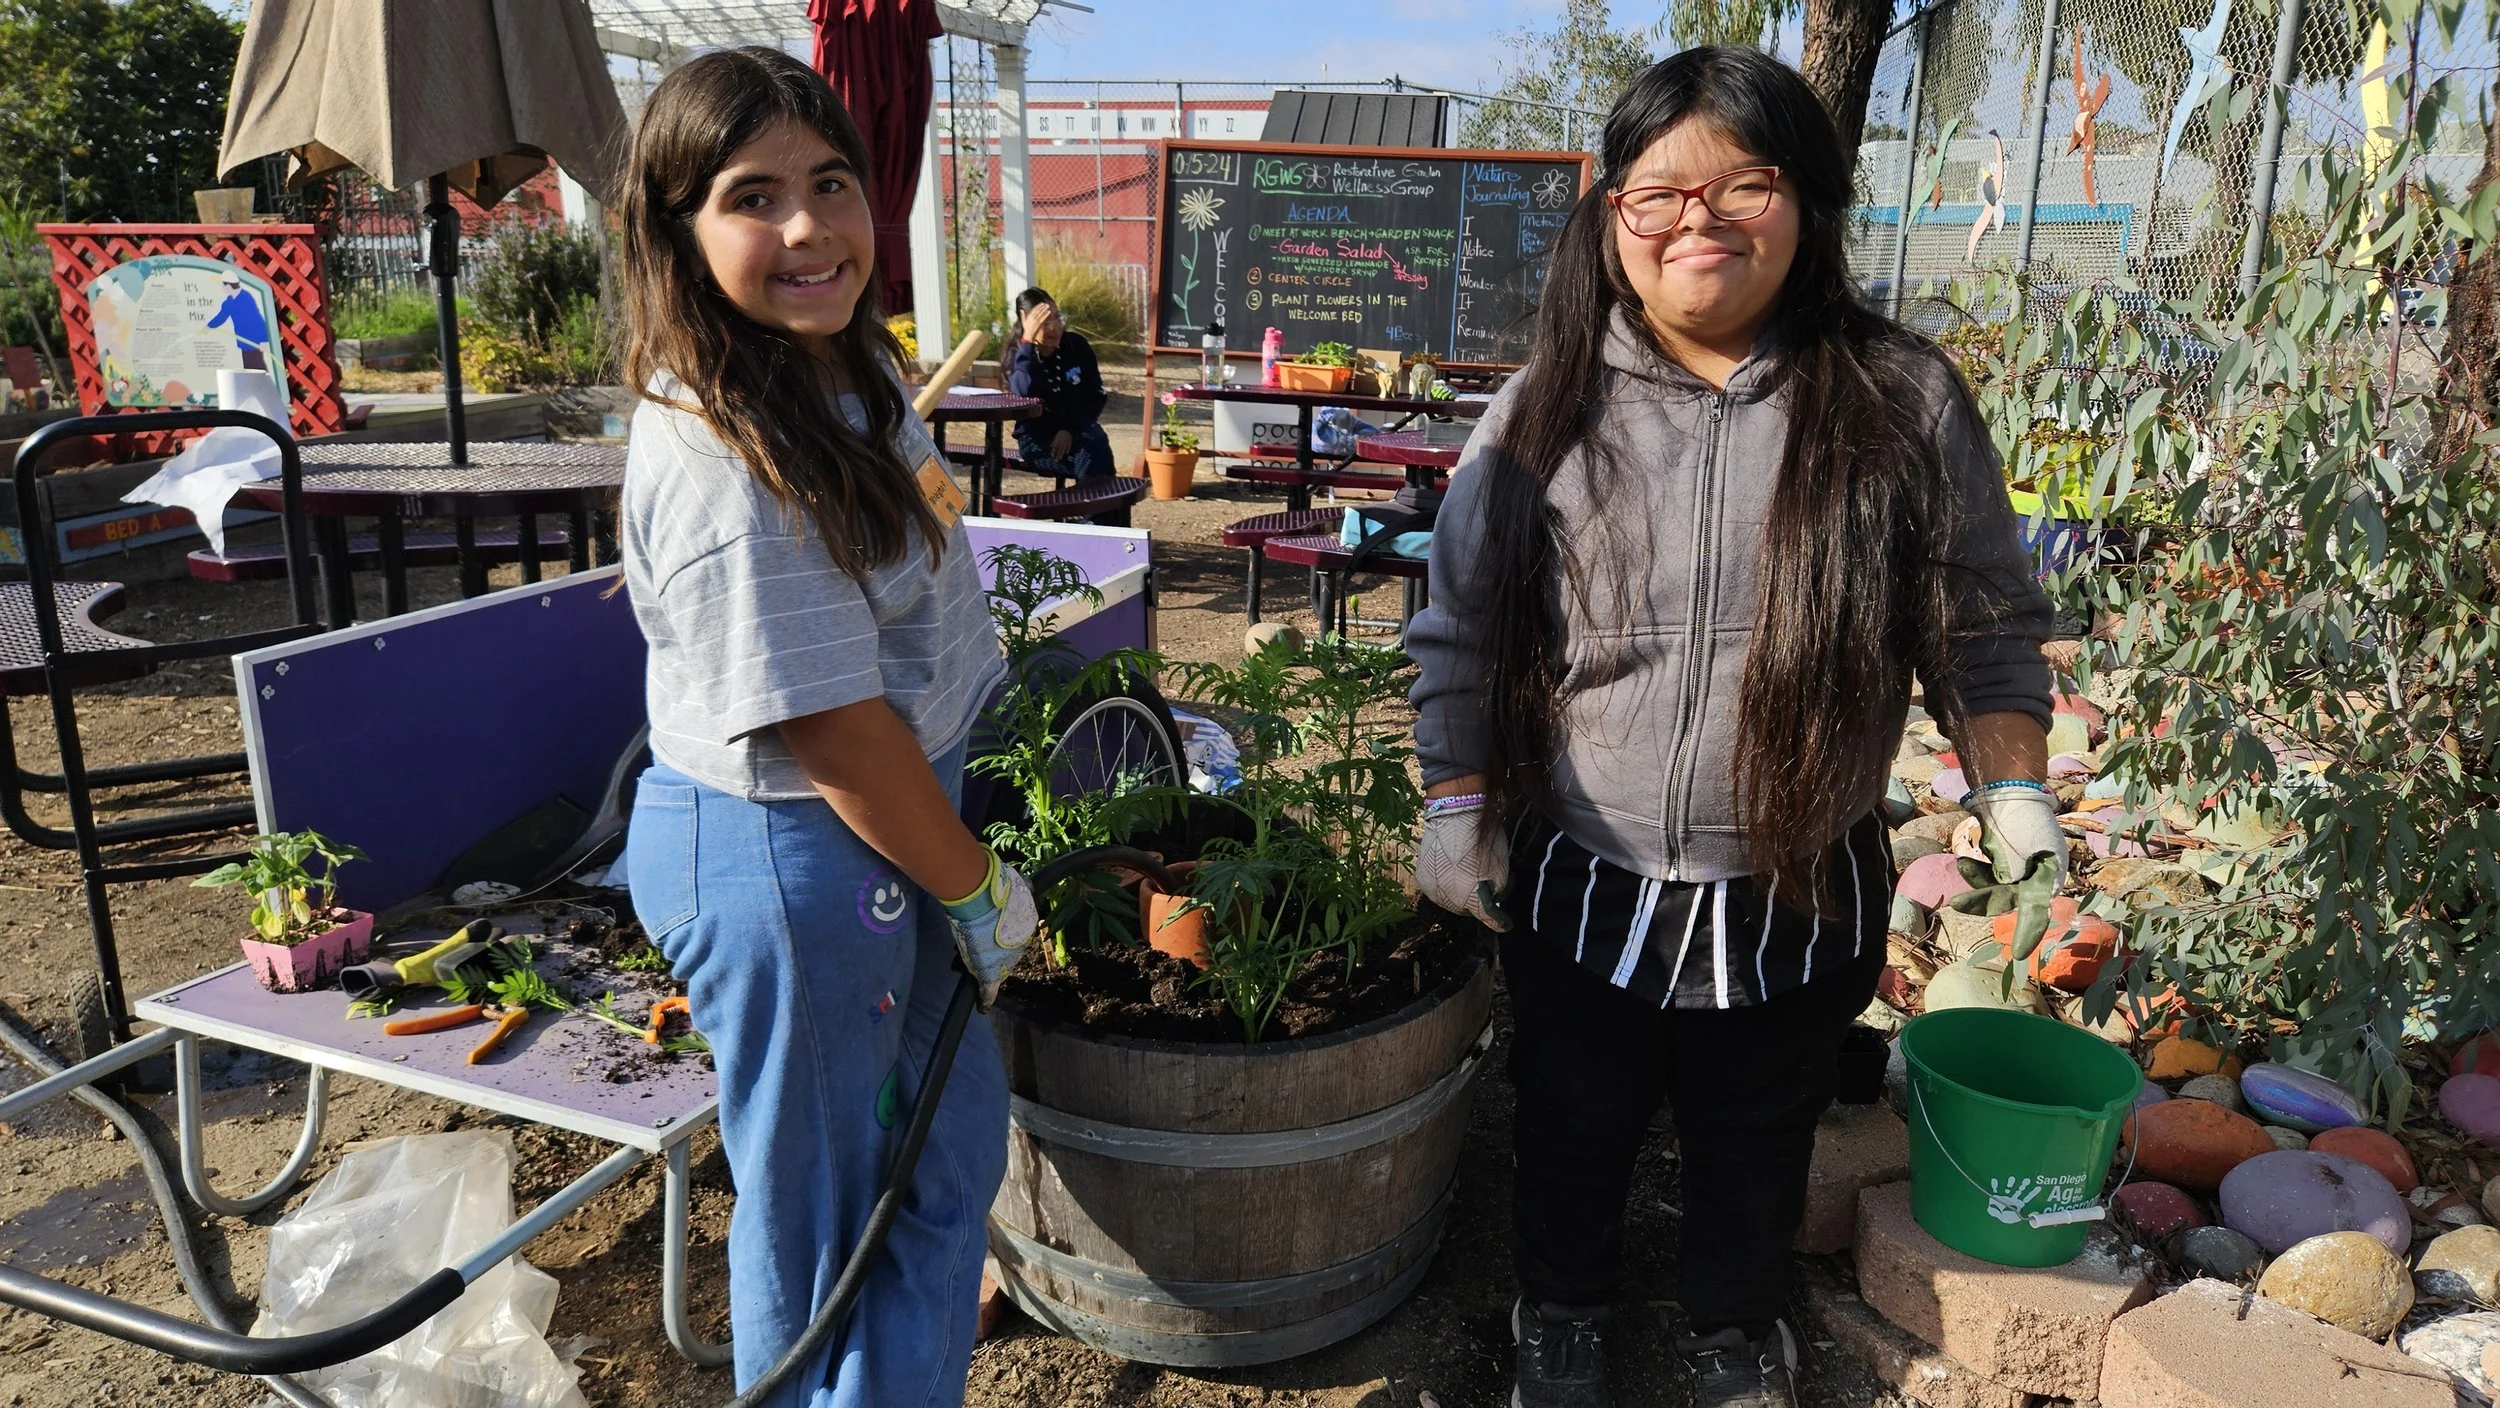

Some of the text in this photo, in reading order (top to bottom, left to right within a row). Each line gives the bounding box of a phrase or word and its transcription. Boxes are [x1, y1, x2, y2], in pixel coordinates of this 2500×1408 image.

[1039, 116, 1049, 132] SS
[1065, 116, 1075, 132] TT
[1141, 117, 1156, 132] WW
[1199, 117, 1209, 133] YY
[1226, 117, 1235, 133] ZZ
[1252, 158, 1308, 189] RGWG
[1333, 160, 1396, 178] Restorative
[1467, 163, 1521, 182] Nature
[1332, 178, 1435, 198] Wellness Group
[1465, 183, 1530, 210] Journaling
[1287, 202, 1354, 222] AGENDA
[1262, 228, 1287, 238] MEET
[1289, 228, 1299, 238] AT
[1301, 228, 1328, 239] WORK
[1330, 229, 1368, 240] BENCH
[1374, 228, 1421, 240] GARDEN
[1422, 227, 1455, 240] SNACK
[1462, 216, 1475, 236] I
[1336, 238, 1384, 259] Salad
[1426, 246, 1448, 256] FOR
[1461, 237, 1494, 257] Notice
[1459, 256, 1473, 271] I
[184, 281, 199, 292] It's
[1213, 227, 1234, 337] WELCOM
[1268, 273, 1310, 285] CENTER
[1313, 275, 1353, 287] CIRCLE
[1459, 273, 1496, 291] Wonder
[187, 297, 196, 306] in
[198, 296, 213, 306] the
[1271, 293, 1310, 308] PLANT
[1316, 294, 1363, 307] FLOWERS
[1367, 293, 1381, 306] IN
[1387, 294, 1408, 307] THE
[1456, 292, 1475, 311] It
[189, 311, 206, 321] Mix
[1288, 309, 1363, 323] WELCOME BED
[104, 514, 162, 541] BED A
[2035, 1173, 2087, 1185] San Diego
[2047, 1185, 2075, 1204] Ag
